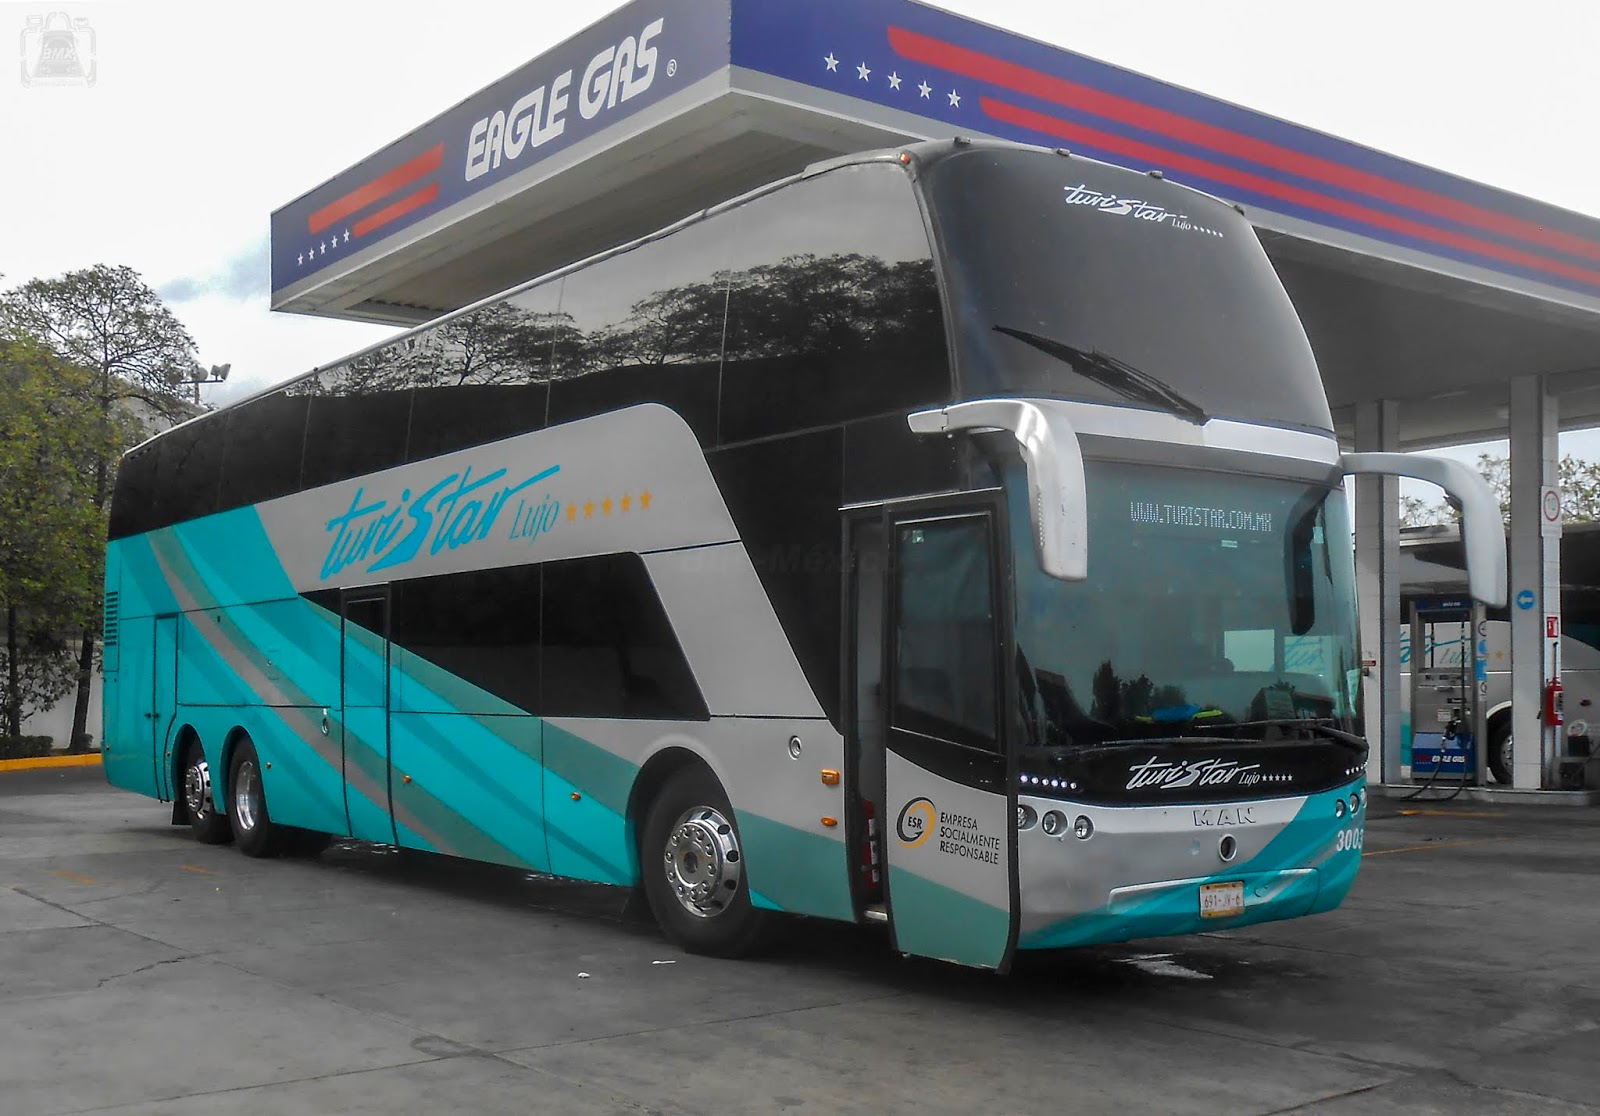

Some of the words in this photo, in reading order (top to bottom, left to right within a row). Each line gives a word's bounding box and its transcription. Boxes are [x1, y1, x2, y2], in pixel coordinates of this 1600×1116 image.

[465, 69, 573, 182] EAGLE
[579, 17, 664, 120] GAS
[1171, 217, 1192, 231] Lujo
[509, 494, 561, 545] Lujo
[1130, 501, 1272, 531] WWW.TURISTAR.COM.MX
[1238, 771, 1261, 787] Lujo
[907, 816, 923, 829] ESR
[940, 812, 978, 830] EMPRESA
[1193, 807, 1256, 826] MAN
[940, 826, 1000, 850] SOCIALMENTE
[940, 841, 999, 865] RESPONSABLE
